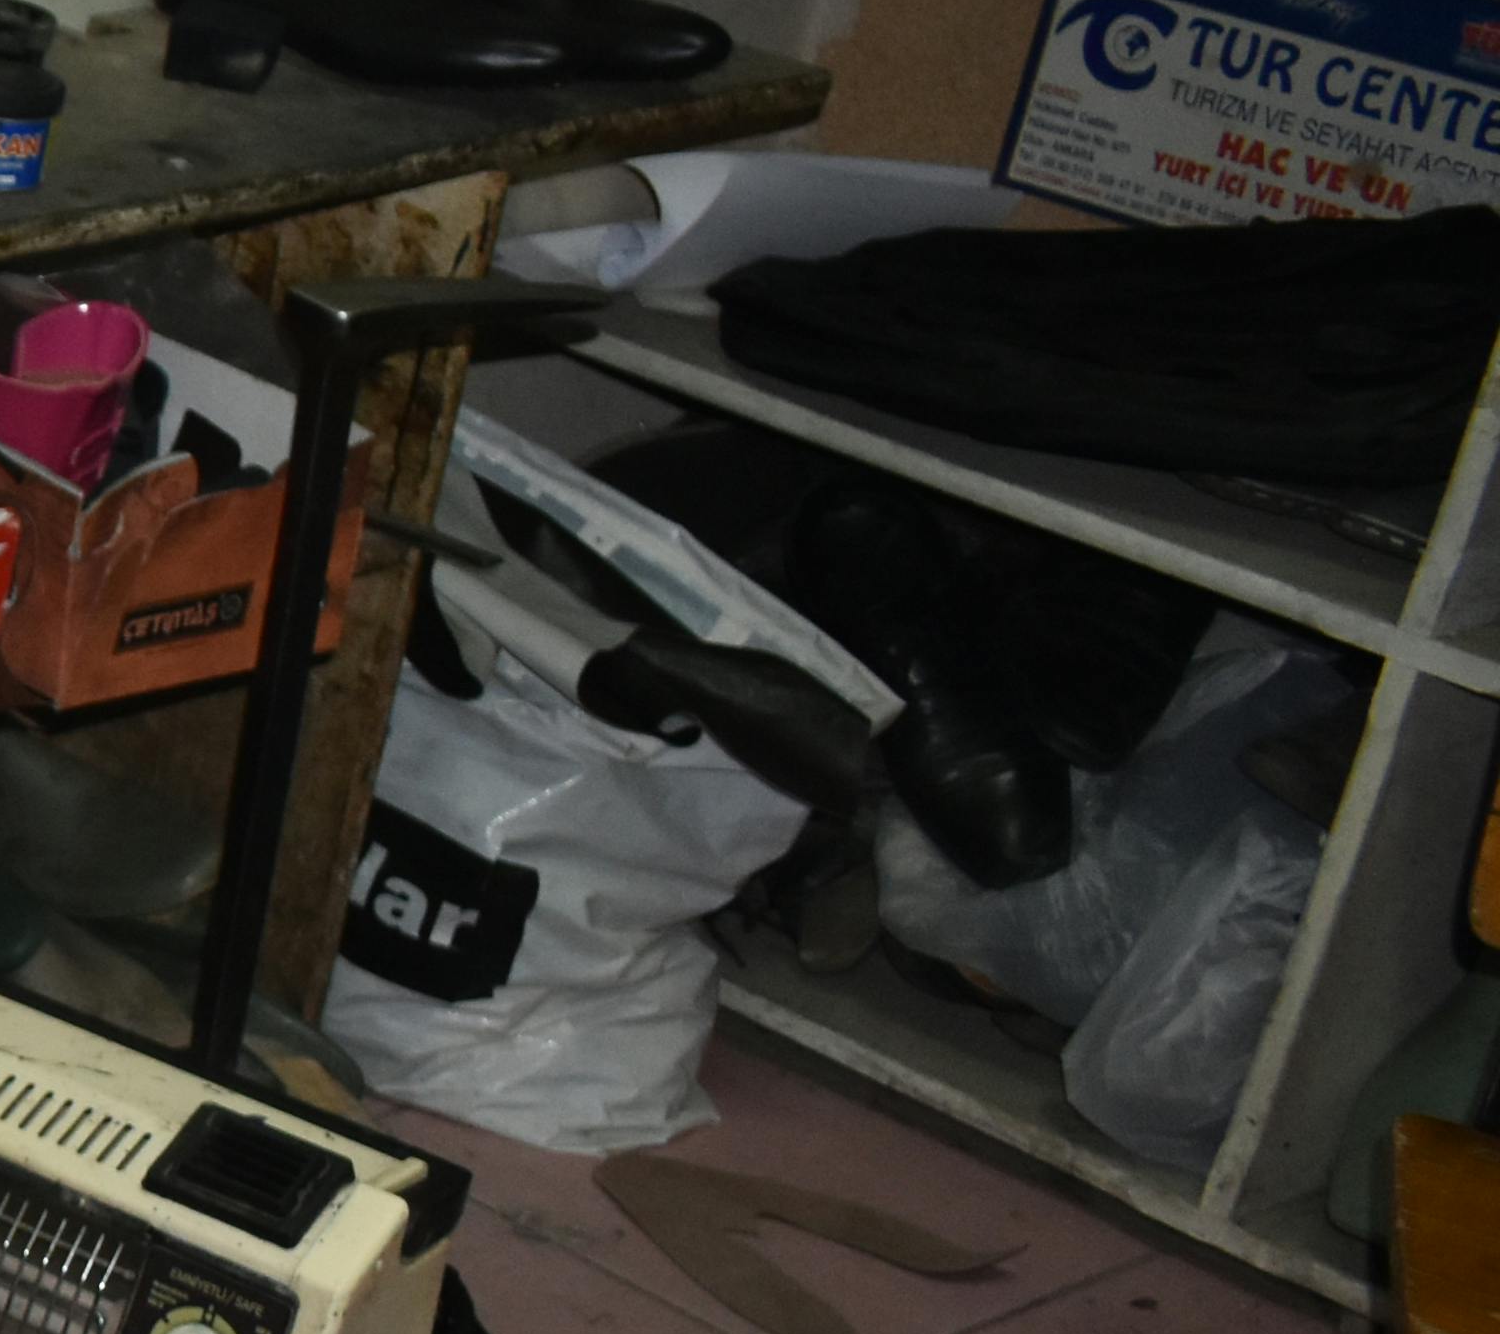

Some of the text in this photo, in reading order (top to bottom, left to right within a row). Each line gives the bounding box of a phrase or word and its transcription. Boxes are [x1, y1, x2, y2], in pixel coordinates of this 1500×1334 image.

[1188, 17, 1303, 95] TUR
[1170, 77, 1259, 124] TURİZM
[1266, 105, 1302, 134] VE
[1301, 118, 1413, 164] SEYAHAT
[1153, 151, 1212, 187] YURT
[1255, 180, 1284, 210] VE
[1217, 131, 1293, 177] HAC
[1306, 156, 1348, 194] VE
